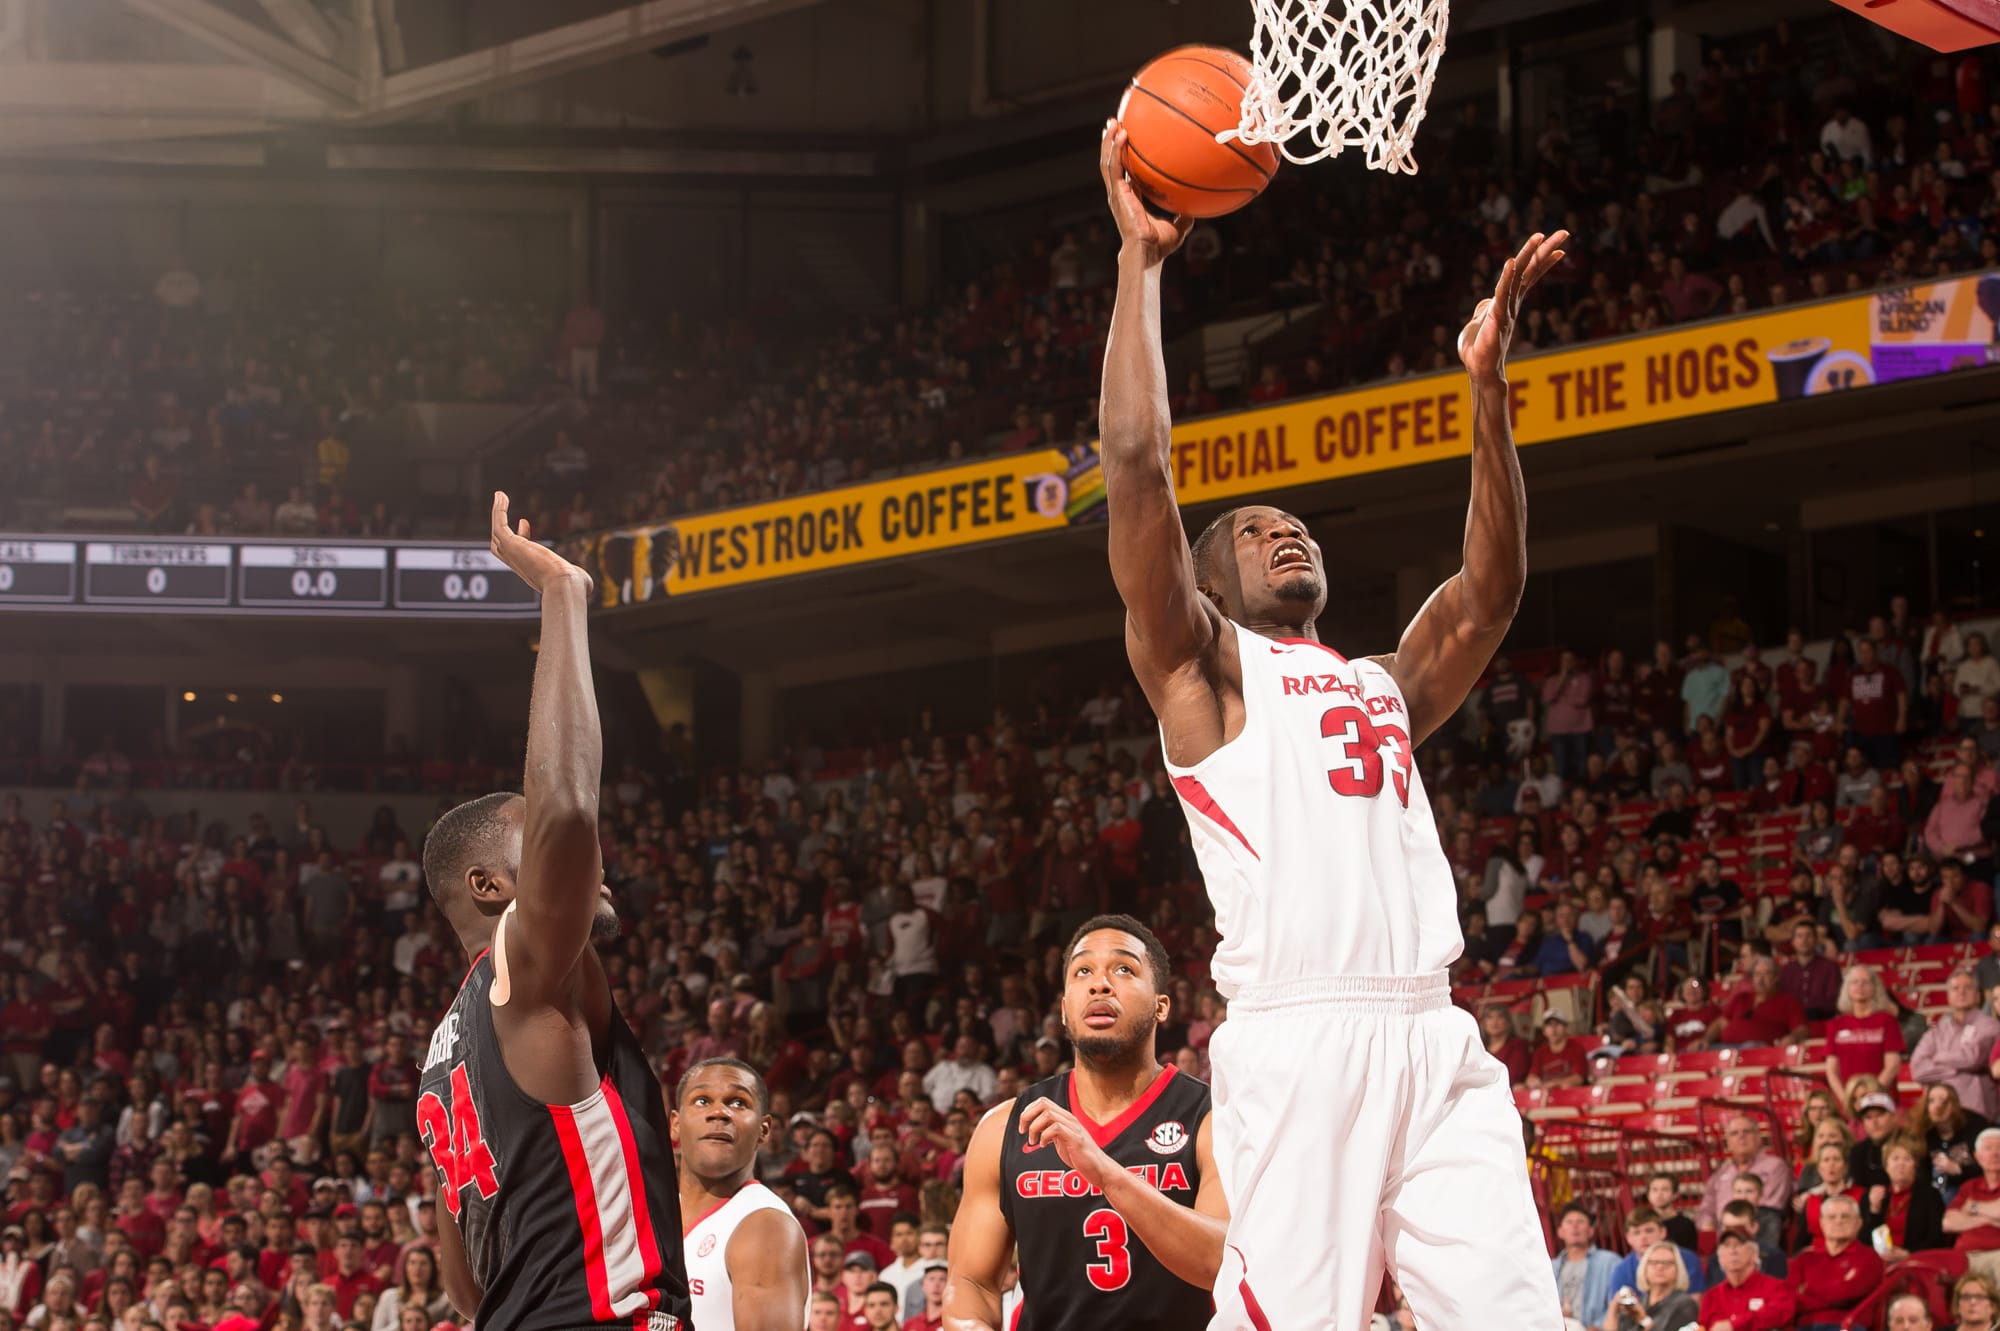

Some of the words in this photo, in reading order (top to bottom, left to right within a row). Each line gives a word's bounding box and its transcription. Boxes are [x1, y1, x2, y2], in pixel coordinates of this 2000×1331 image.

[1880, 300, 1946, 317] AFRICAN
[1881, 316, 1930, 333] BLEND
[1171, 424, 1297, 489] FICIAL
[1314, 394, 1460, 463] COFFEE
[1508, 379, 1529, 430] F
[1548, 360, 1626, 422] THE
[1646, 338, 1760, 405] HOGS
[677, 501, 865, 580] WESTROCK
[881, 473, 1016, 542] COFFEE
[112, 545, 208, 565] TURNOVERS
[146, 567, 167, 594] 0
[291, 570, 337, 597] 0.0
[443, 574, 489, 600] 0.0
[1319, 705, 1413, 809] 33
[417, 1061, 500, 1224] 34
[1154, 1121, 1182, 1146] SEC
[1016, 1162, 1191, 1198] GEOIA
[1083, 1208, 1131, 1292] 3
